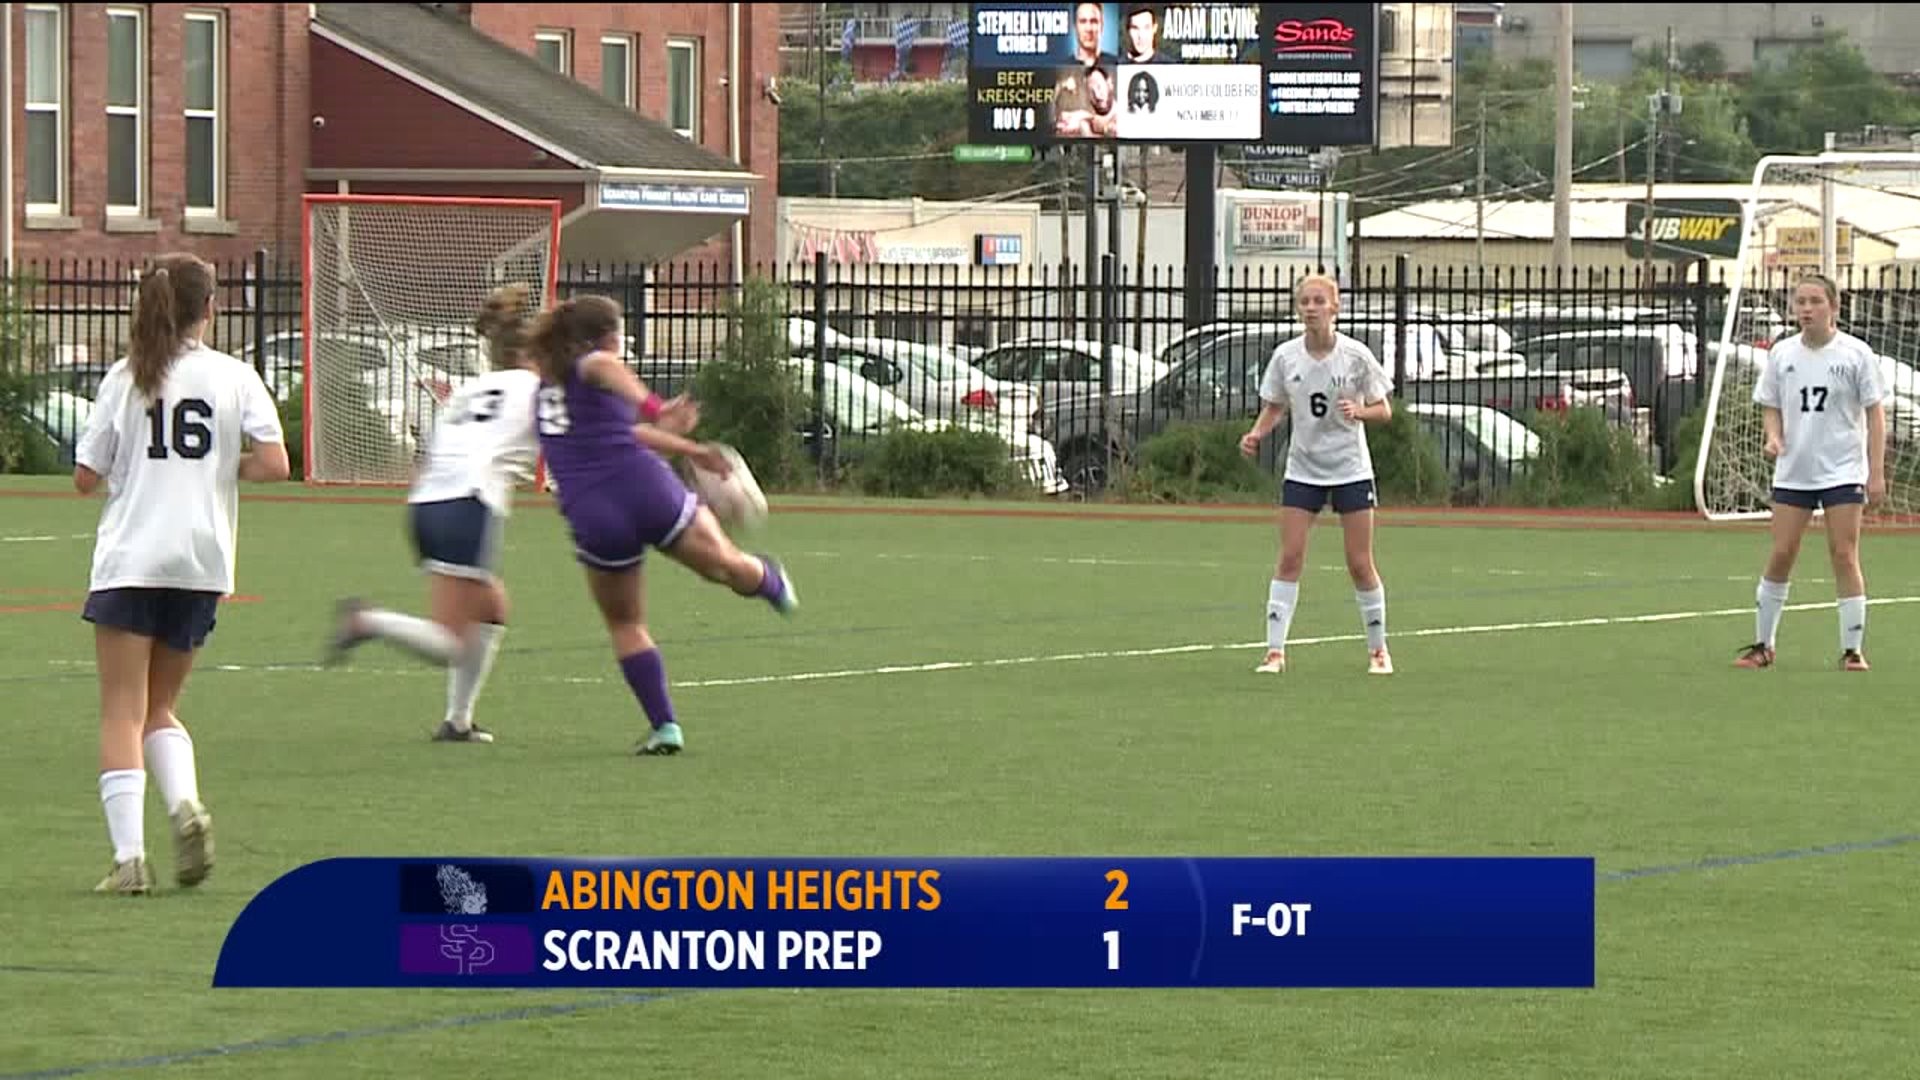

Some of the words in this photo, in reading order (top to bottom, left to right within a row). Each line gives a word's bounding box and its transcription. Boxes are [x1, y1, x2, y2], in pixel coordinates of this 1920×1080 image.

[978, 11, 1028, 34] STEPHEN
[1031, 11, 1068, 34] LYNCH
[1163, 7, 1206, 39] ADAM
[1210, 7, 1259, 39] DEVINE
[1274, 19, 1354, 41] Sands
[997, 71, 1034, 85] BERT
[978, 88, 1054, 103] KREISCHER
[1205, 84, 1258, 97] GOLDBERG
[993, 108, 1022, 129] NOV
[1025, 108, 1035, 129] 9
[1243, 207, 1302, 221] DUNLOP
[1256, 222, 1287, 231] TIRES
[1631, 217, 1728, 240] SUBWAY
[1310, 392, 1327, 417] 6
[1800, 386, 1828, 412] 17
[146, 398, 212, 458] 16
